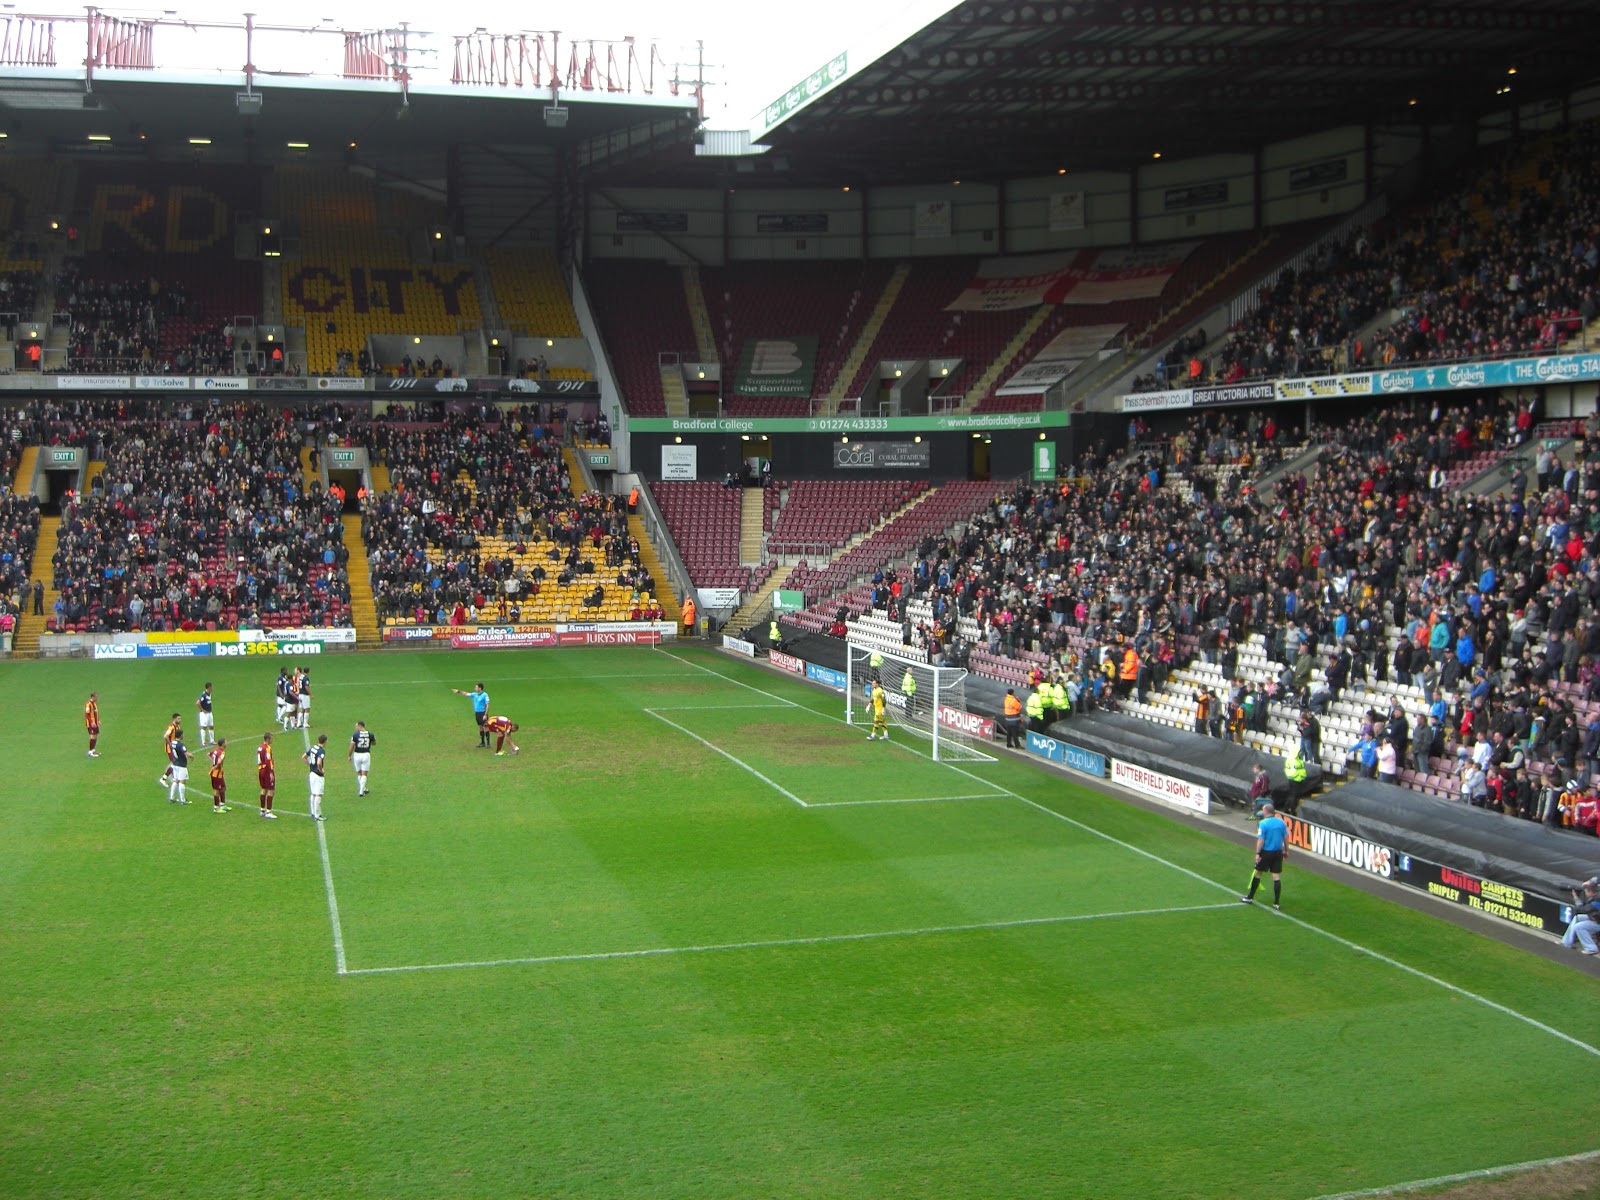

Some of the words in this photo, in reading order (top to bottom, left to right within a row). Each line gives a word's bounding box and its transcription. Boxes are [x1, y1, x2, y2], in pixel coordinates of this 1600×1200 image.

[288, 267, 473, 315] CITY
[1516, 364, 1533, 378] THE
[1536, 358, 1579, 379] Carlsberg
[153, 378, 185, 386] TriSolve
[1380, 373, 1414, 390] Carlsberg
[1447, 367, 1485, 386] Carlsberg
[215, 381, 240, 389] Mitton
[389, 378, 418, 390] 1911
[557, 381, 586, 391] 1911
[1194, 390, 1215, 402] GREAT
[1216, 388, 1249, 401] VICTORIA
[1250, 386, 1274, 399] HOTEL
[672, 419, 716, 429] Bradford
[719, 419, 754, 431] College
[819, 419, 849, 429] 01274
[851, 419, 888, 429] 433333
[948, 414, 1041, 427] www.bradfordcollege.ac.uk
[54, 452, 69, 461] EXIT
[334, 452, 349, 460] EXIT
[590, 456, 604, 464] EXIT
[837, 448, 875, 464] Coral
[568, 624, 598, 632] Amari
[459, 634, 486, 642] VERNON
[585, 633, 615, 643] JURYS
[617, 633, 636, 642] INN
[96, 644, 136, 654] MCD
[215, 641, 321, 656] bet365.com
[770, 650, 796, 668] NAPOLEONS
[943, 707, 984, 735] npower
[357, 737, 370, 748] 23
[1032, 735, 1057, 759] map
[1116, 762, 1164, 790] BUTTERFIELD
[1166, 780, 1191, 799] SIGNS
[1481, 880, 1524, 901] CARPETS
[1428, 882, 1459, 901] SHIPLEY
[1468, 895, 1483, 910] TEL:
[1484, 900, 1508, 918] 01274
[1508, 907, 1543, 929] 533408
